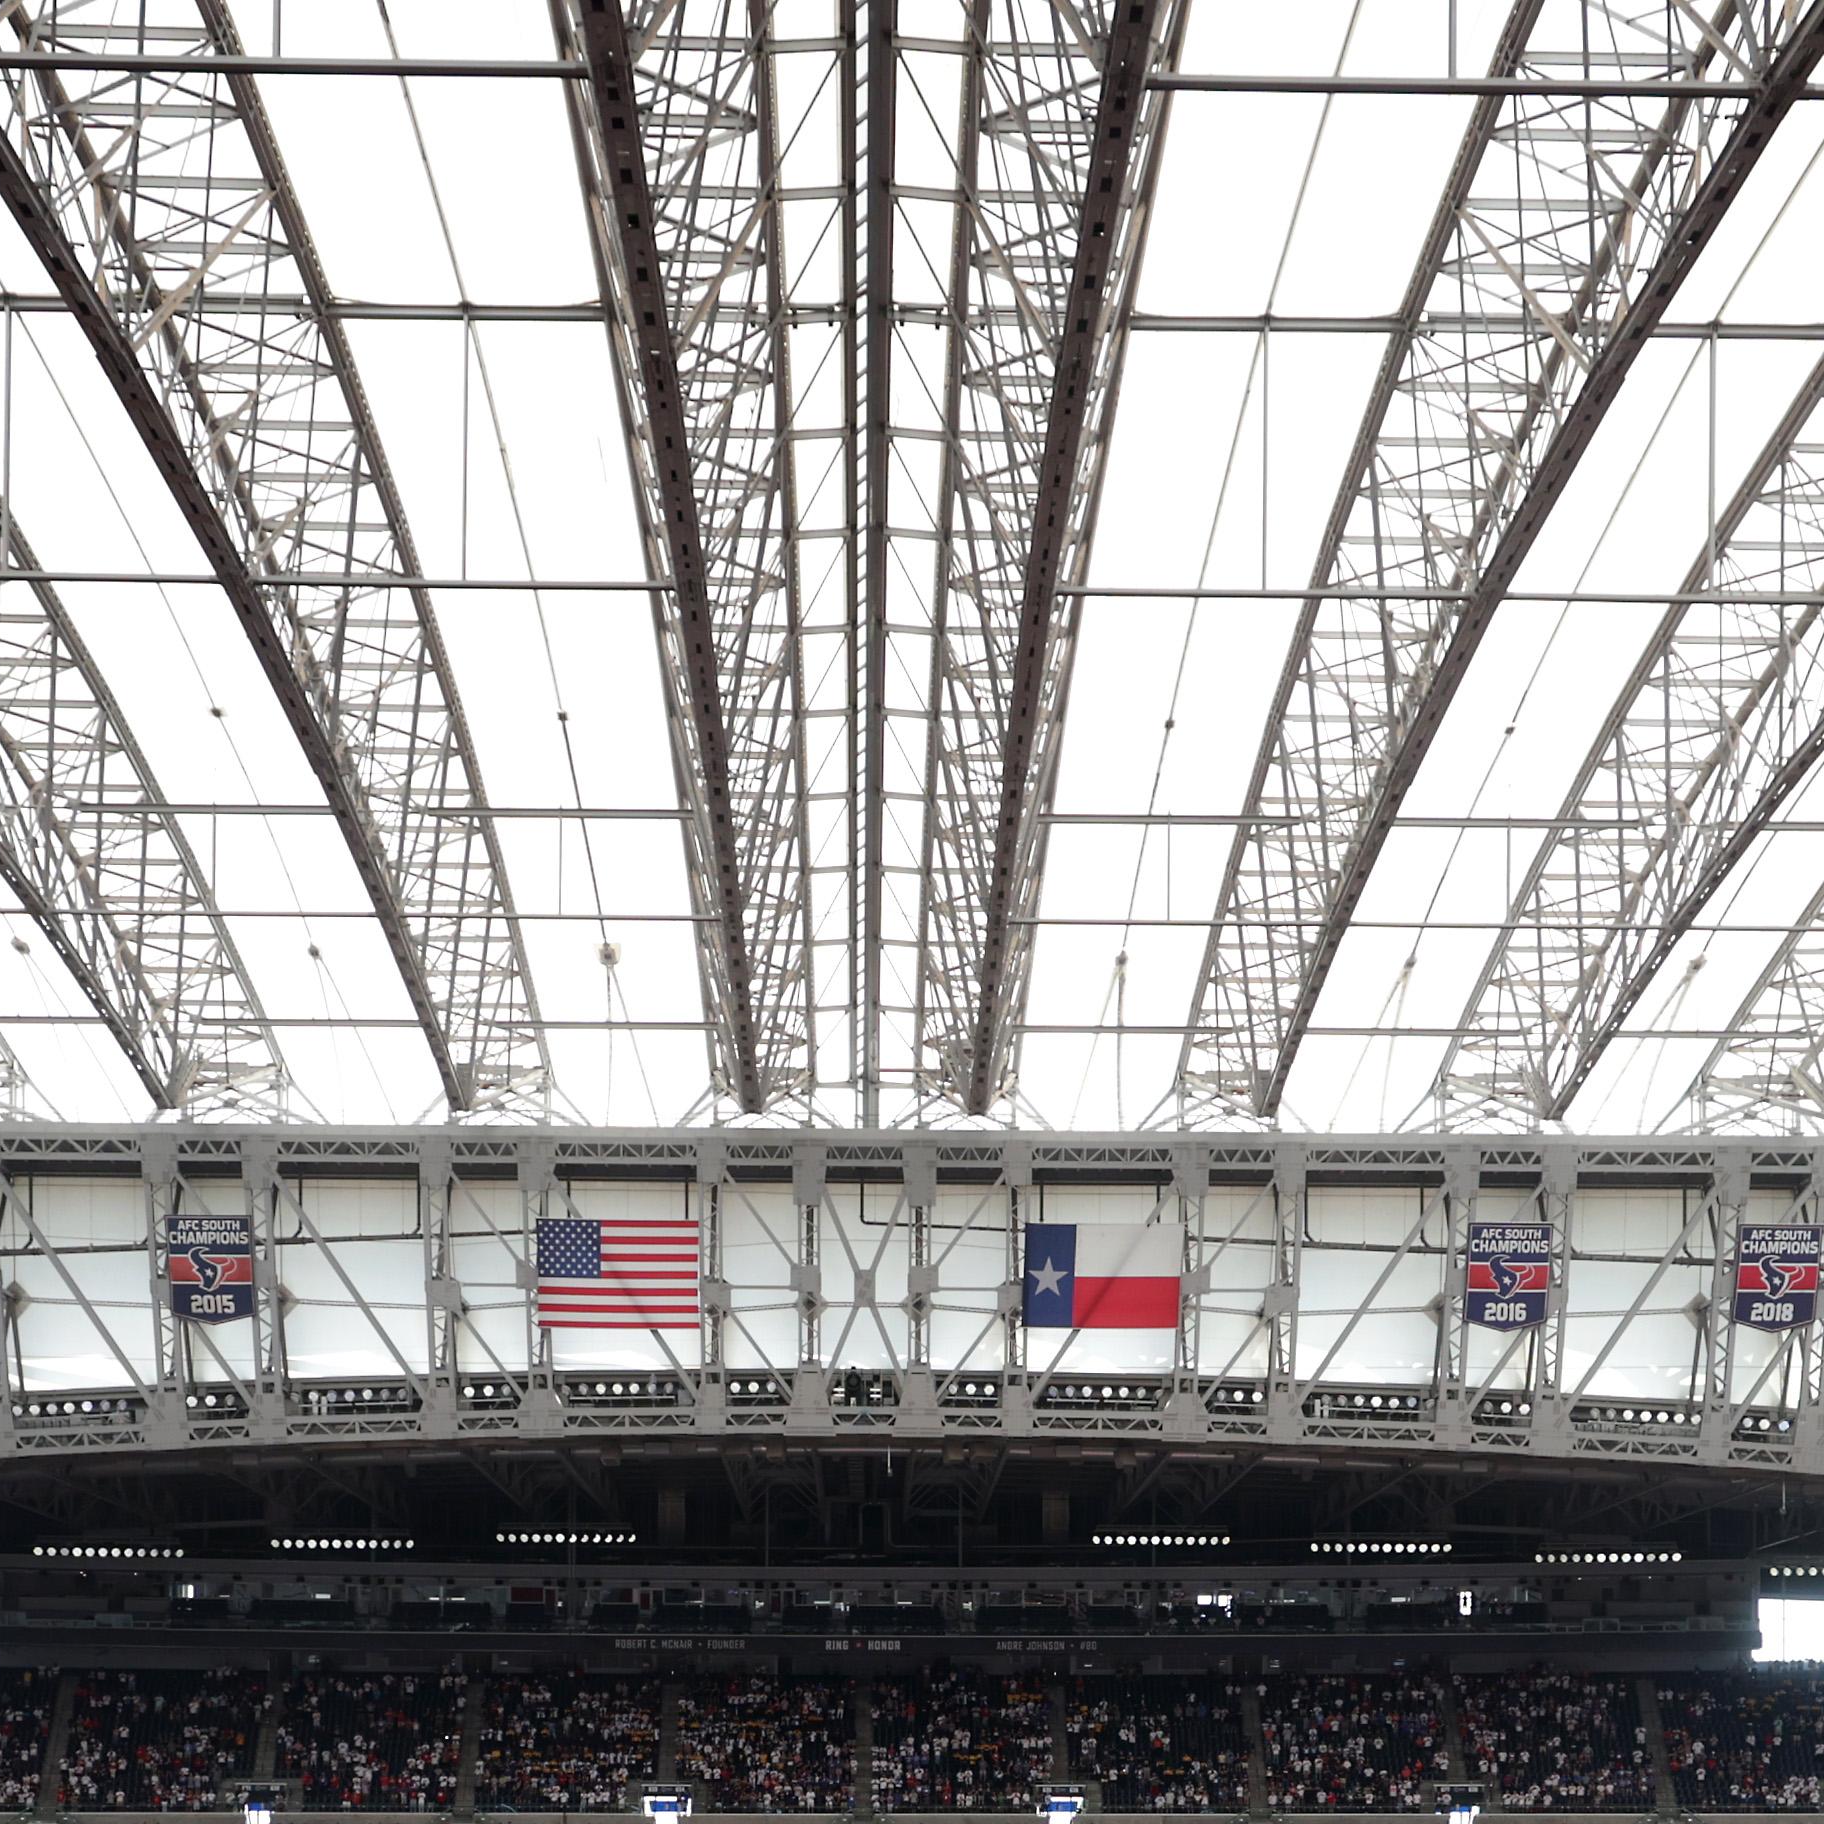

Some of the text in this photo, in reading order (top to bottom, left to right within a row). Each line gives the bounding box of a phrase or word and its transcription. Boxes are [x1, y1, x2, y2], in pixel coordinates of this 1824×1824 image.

[178, 1220, 240, 1230] AFC SOUTH
[169, 1231, 248, 1244] CHAMPIONS
[1481, 1229, 1541, 1239] AFC SOUTH
[1751, 1230, 1811, 1240] AFC SOUTH
[1472, 1240, 1548, 1253] CHAMPIONS
[1742, 1241, 1818, 1254] CHAMPIONS
[190, 1295, 235, 1314] 2015
[1484, 1302, 1527, 1322] 2016
[1751, 1302, 1794, 1321] 2018
[615, 1639, 646, 1649] ROBERT
[707, 1639, 745, 1649] FOUNDER
[825, 1640, 900, 1650] RING HONOR
[996, 1640, 1023, 1650] ANDRE
[1026, 1640, 1065, 1650] JOHNSON
